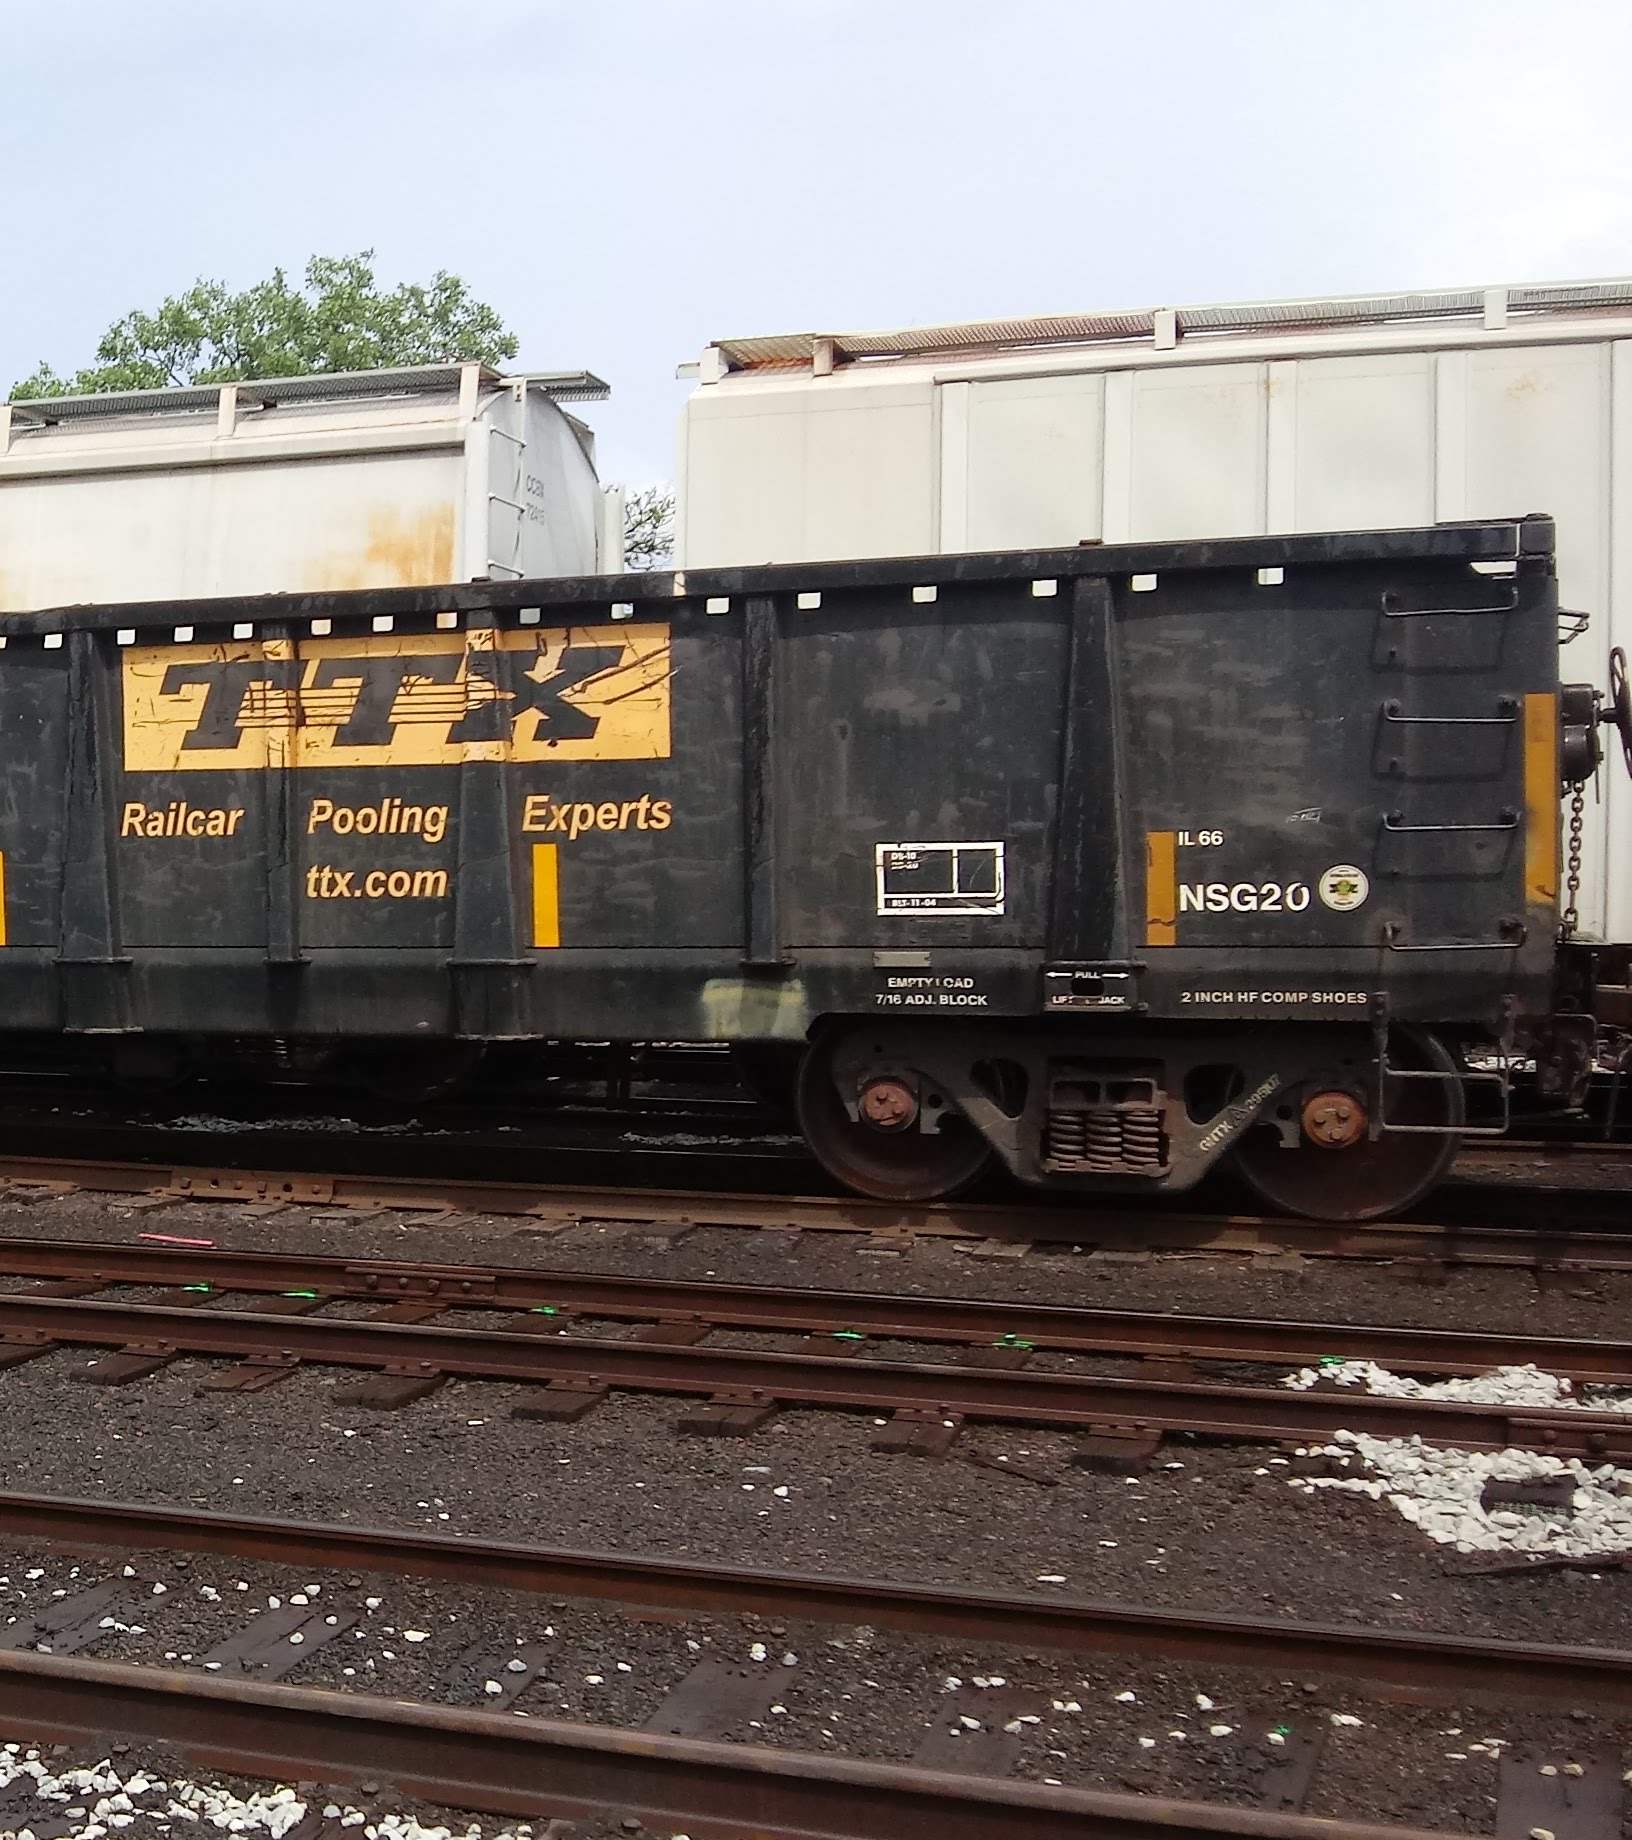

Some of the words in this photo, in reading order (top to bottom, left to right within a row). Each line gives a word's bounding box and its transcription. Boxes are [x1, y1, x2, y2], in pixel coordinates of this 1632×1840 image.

[154, 640, 634, 752] TTX
[120, 802, 244, 837] Railcar
[308, 797, 448, 843] Pooling
[522, 793, 672, 840] Experts
[1178, 832, 1195, 846] IL
[1198, 831, 1224, 846] 66
[306, 863, 448, 898] ttx.com
[1179, 882, 1310, 912] NSG20
[1074, 971, 1101, 979] PULL
[887, 977, 934, 988] EMPTY
[875, 994, 902, 1005] 7/16
[905, 994, 937, 1005] ADJ.
[939, 994, 988, 1006] BLOCK
[1098, 996, 1126, 1004] JACK
[1181, 992, 1192, 1003] 2
[1195, 992, 1234, 1003] INCH
[1237, 992, 1259, 1003] HF
[1261, 992, 1309, 1003] COMP
[1311, 992, 1368, 1004] SHOES
